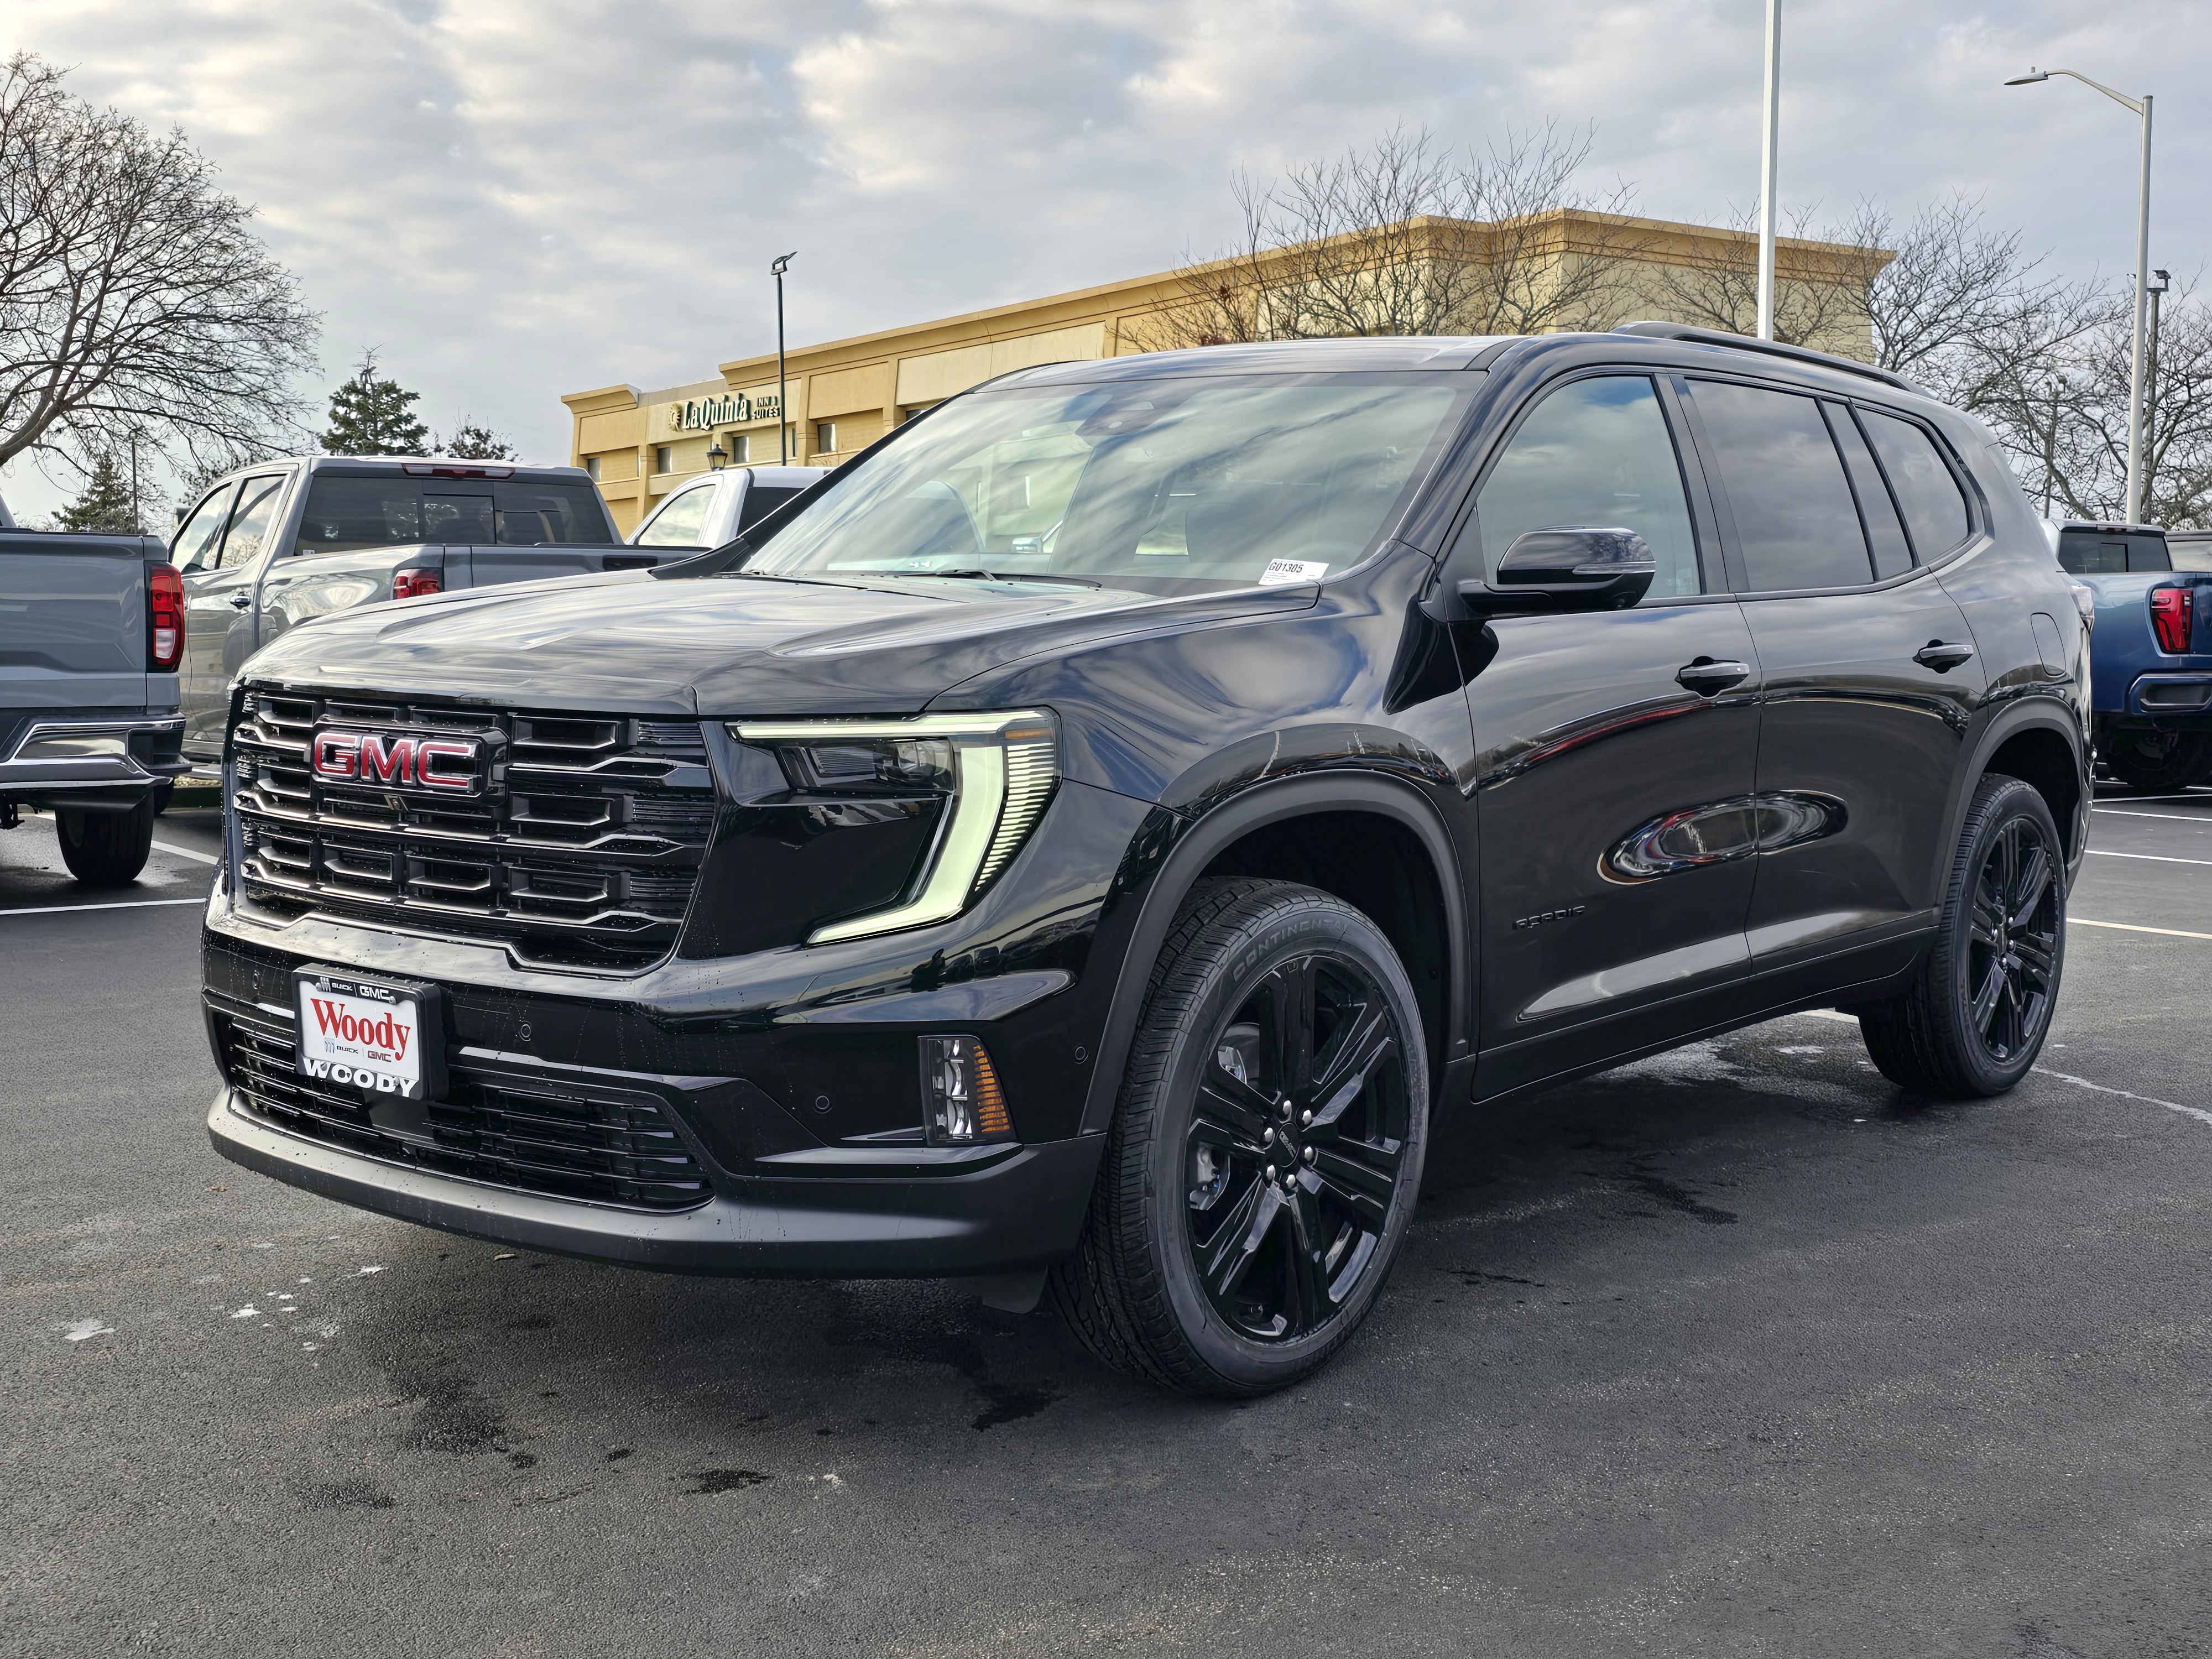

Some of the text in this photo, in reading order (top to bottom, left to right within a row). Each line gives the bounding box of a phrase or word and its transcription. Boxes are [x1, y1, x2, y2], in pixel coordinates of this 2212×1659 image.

[752, 407, 780, 419] SUITES
[1269, 562, 1304, 573] G01305
[315, 732, 477, 790] GMC
[332, 983, 389, 1001] BUICK GMC
[310, 998, 411, 1061] Woody
[336, 1045, 392, 1062] BUICK GMC
[303, 1058, 419, 1098] WOODY
